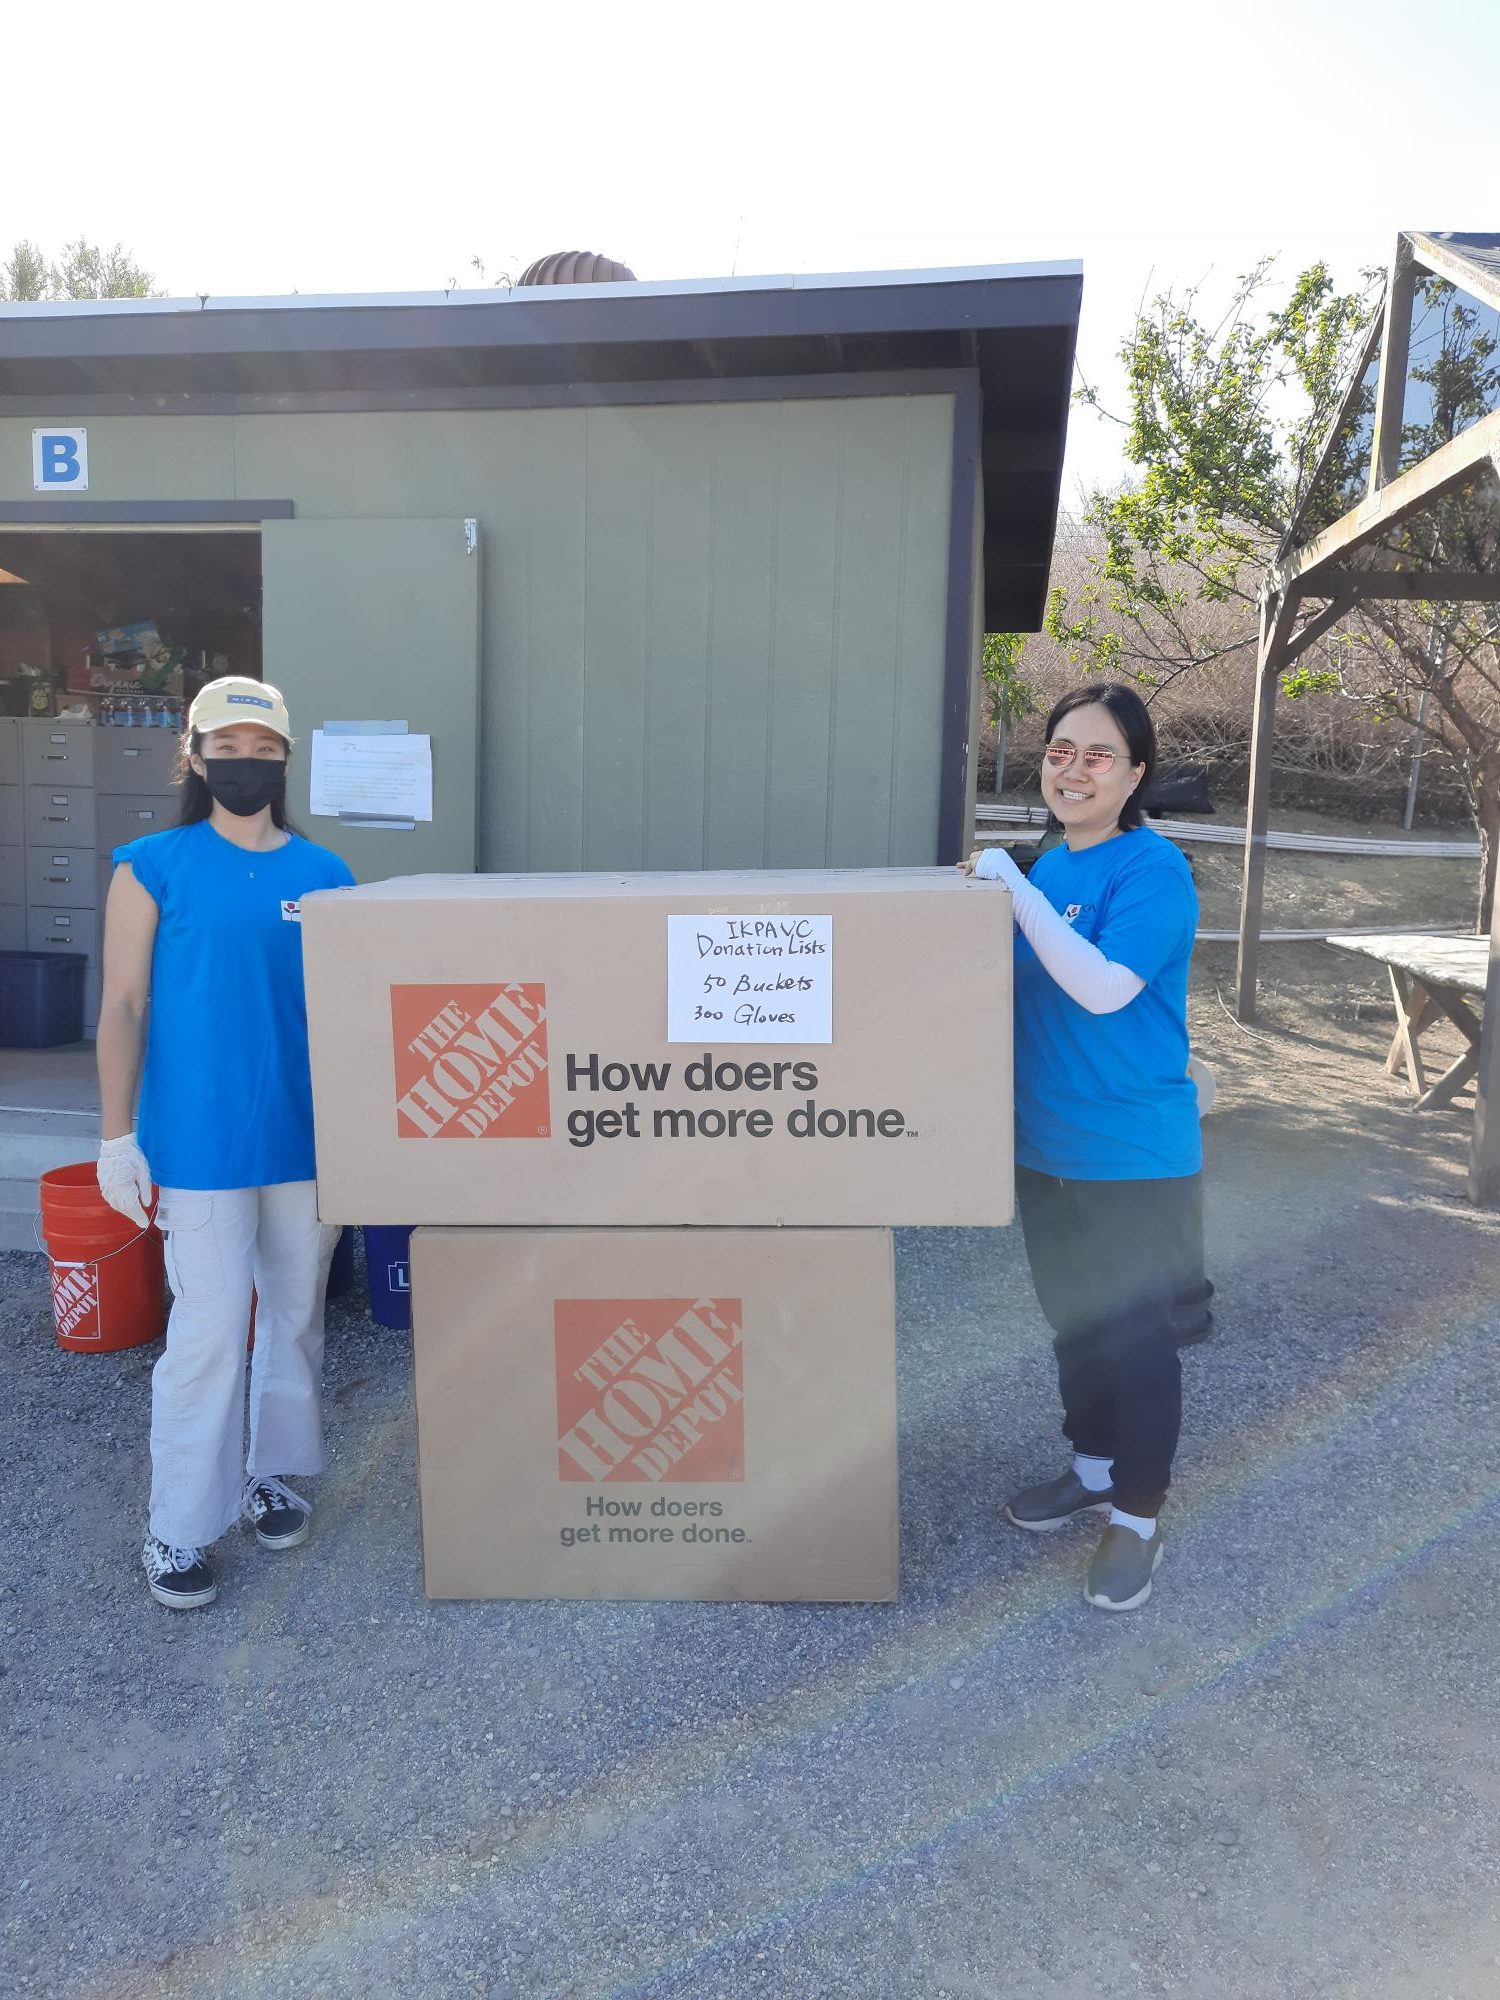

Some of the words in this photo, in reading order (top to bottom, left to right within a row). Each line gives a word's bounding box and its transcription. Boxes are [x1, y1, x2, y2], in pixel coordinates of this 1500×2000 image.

[41, 435, 81, 483] B
[696, 932, 784, 959] Donation
[788, 934, 827, 955] Lists
[726, 919, 813, 940] IKPAVC
[703, 973, 726, 994] 50
[732, 972, 814, 996] Buckets
[407, 999, 472, 1062] THE
[694, 1005, 724, 1021] 300
[733, 1003, 796, 1026] Gloves
[397, 982, 548, 1138] HOME
[566, 1053, 672, 1092] How
[684, 1052, 819, 1092] doers
[456, 1040, 549, 1139] DEPOT
[567, 1102, 641, 1148] get
[653, 1108, 774, 1138] more
[60, 1291, 98, 1336] DEPOT
[573, 1317, 651, 1391] THE
[558, 1298, 745, 1482] HOME
[631, 1366, 745, 1482] DEPOT
[586, 1496, 643, 1517] How
[650, 1496, 723, 1517] doers
[560, 1524, 601, 1547] get
[608, 1526, 674, 1543] more
